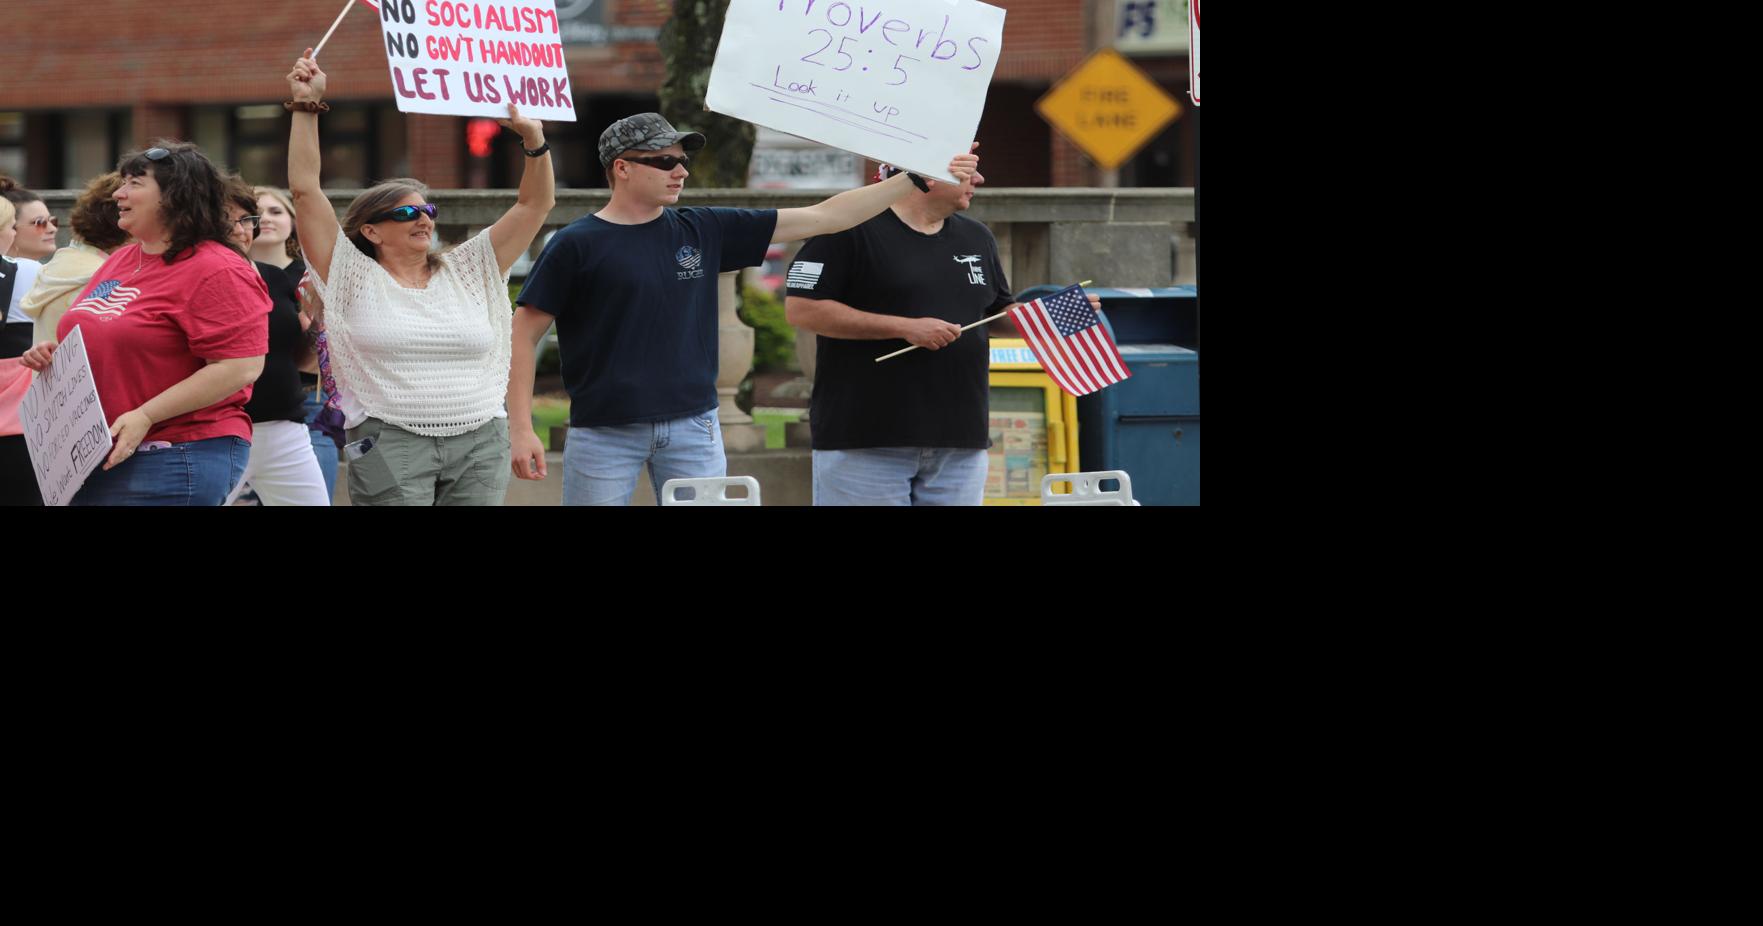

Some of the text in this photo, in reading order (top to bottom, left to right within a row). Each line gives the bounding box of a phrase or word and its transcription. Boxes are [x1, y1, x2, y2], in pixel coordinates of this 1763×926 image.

[382, 0, 415, 24] NO
[425, 0, 558, 34] SOCIALISM
[387, 31, 563, 68] NO GOV'T HANDOUT
[394, 67, 573, 108] LET US WORK
[774, 65, 816, 95] Look
[873, 101, 899, 123] up
[1080, 86, 1128, 102] FIRE
[71, 421, 107, 474] FREEDOM
